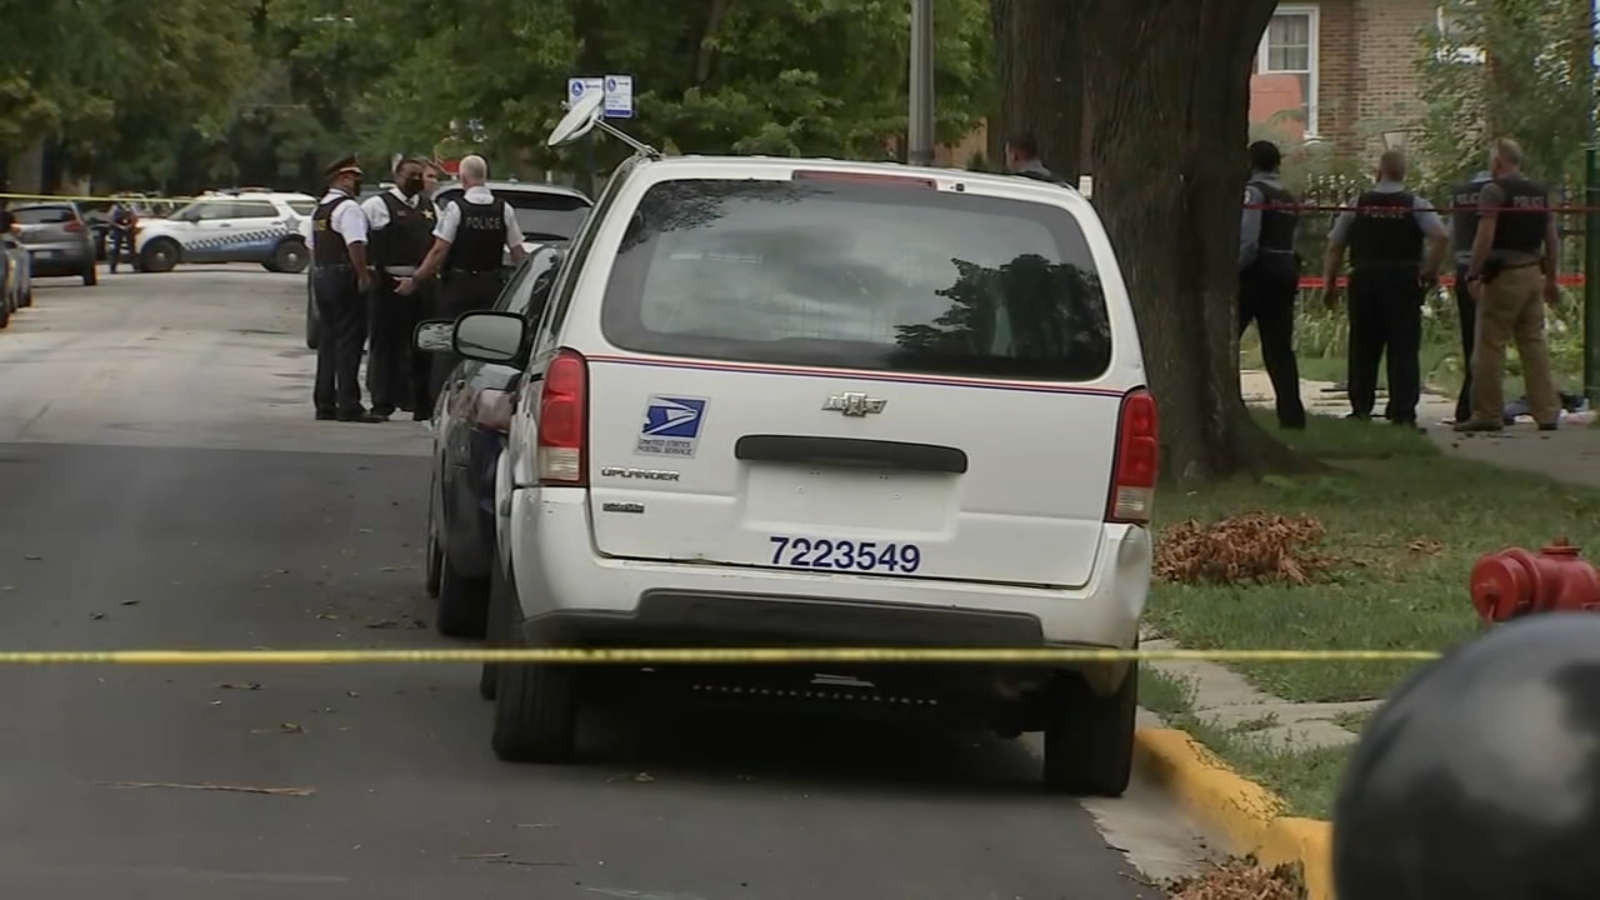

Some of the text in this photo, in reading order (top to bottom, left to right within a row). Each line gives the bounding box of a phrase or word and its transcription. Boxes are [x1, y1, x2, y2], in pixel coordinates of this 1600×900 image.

[466, 216, 502, 230] POLICE
[601, 466, 680, 482] UPLANDER
[770, 536, 921, 573] 7223549
